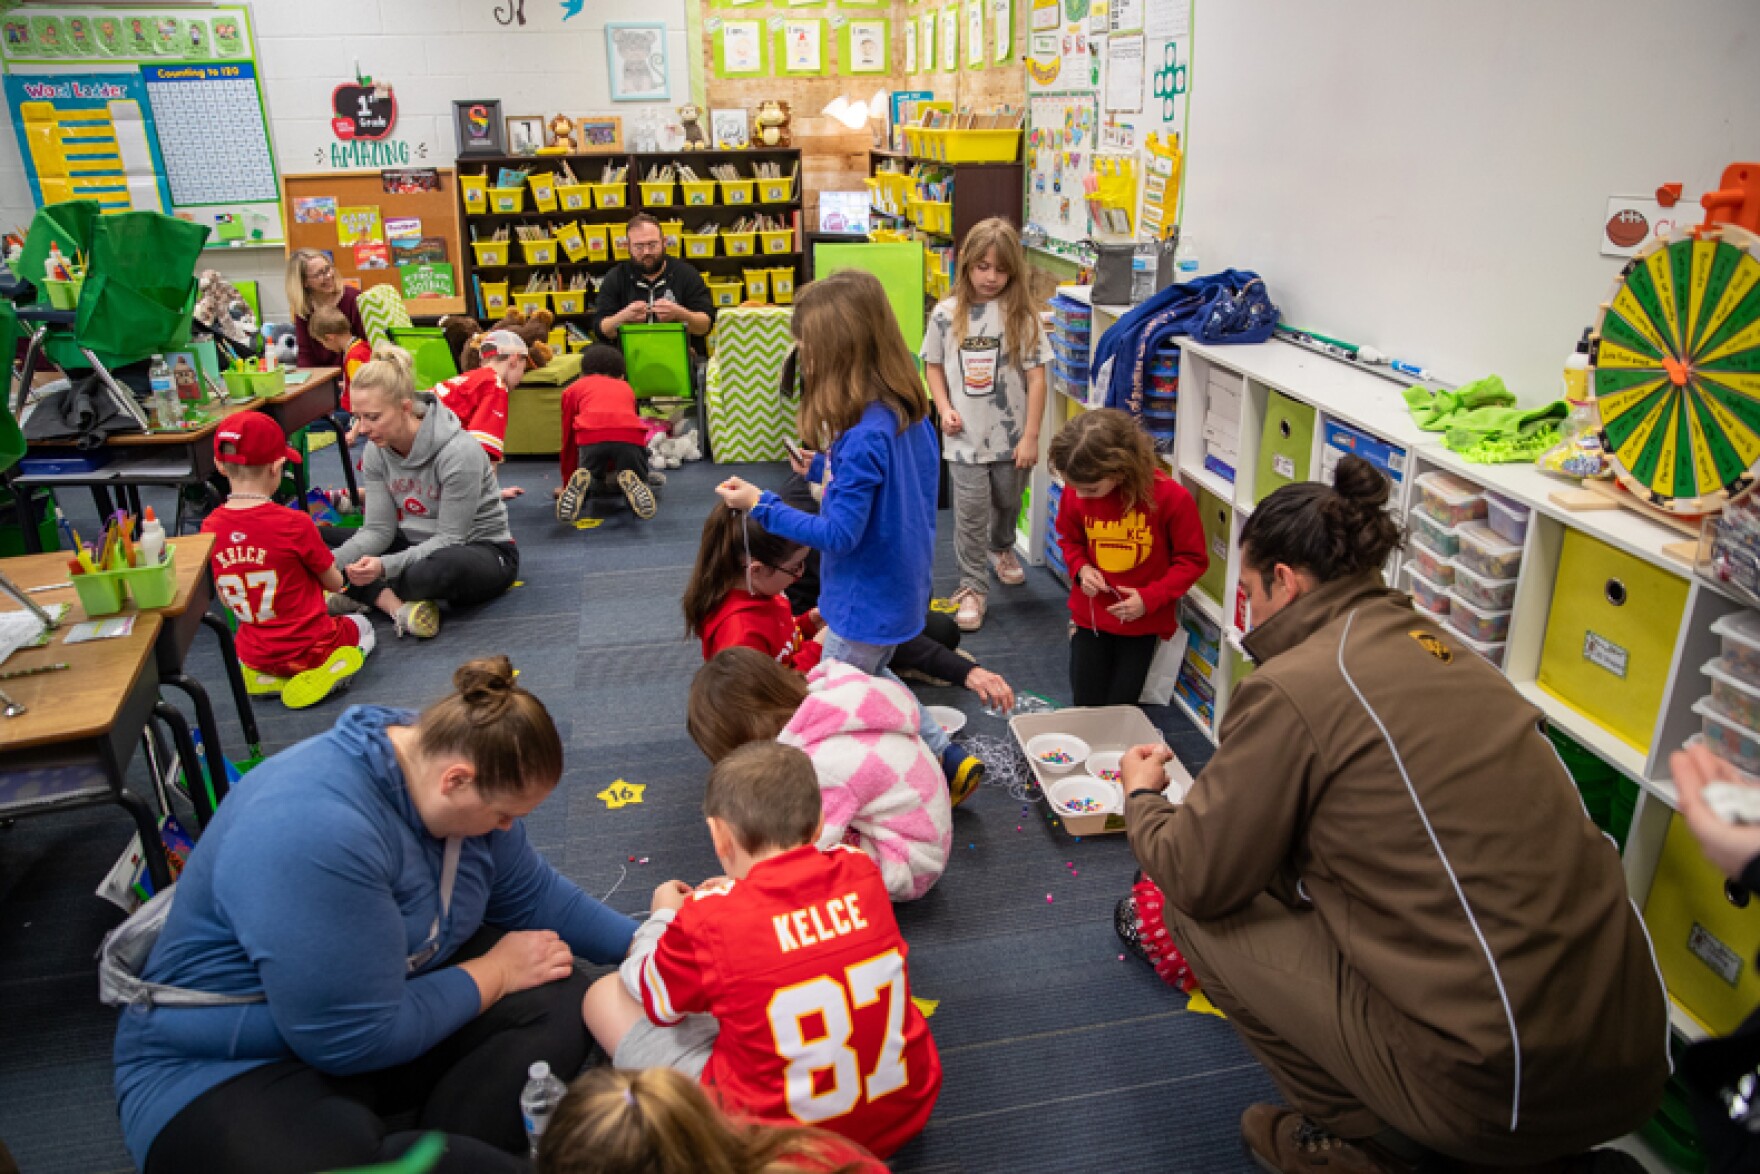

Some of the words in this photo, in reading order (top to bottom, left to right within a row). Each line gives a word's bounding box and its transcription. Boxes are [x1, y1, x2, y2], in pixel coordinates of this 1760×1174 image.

[157, 67, 205, 79] Counting
[207, 67, 219, 76] to
[220, 66, 239, 76] 120
[23, 82, 71, 99] Word
[72, 81, 128, 98] Ladder
[331, 139, 409, 168] AMAZING
[341, 213, 376, 224] GAME
[1127, 527, 1146, 540] KC
[215, 546, 267, 569] KELCE
[217, 569, 278, 624] 87
[609, 786, 634, 802] 16
[772, 893, 869, 953] KELCE
[767, 947, 909, 1126] 87
